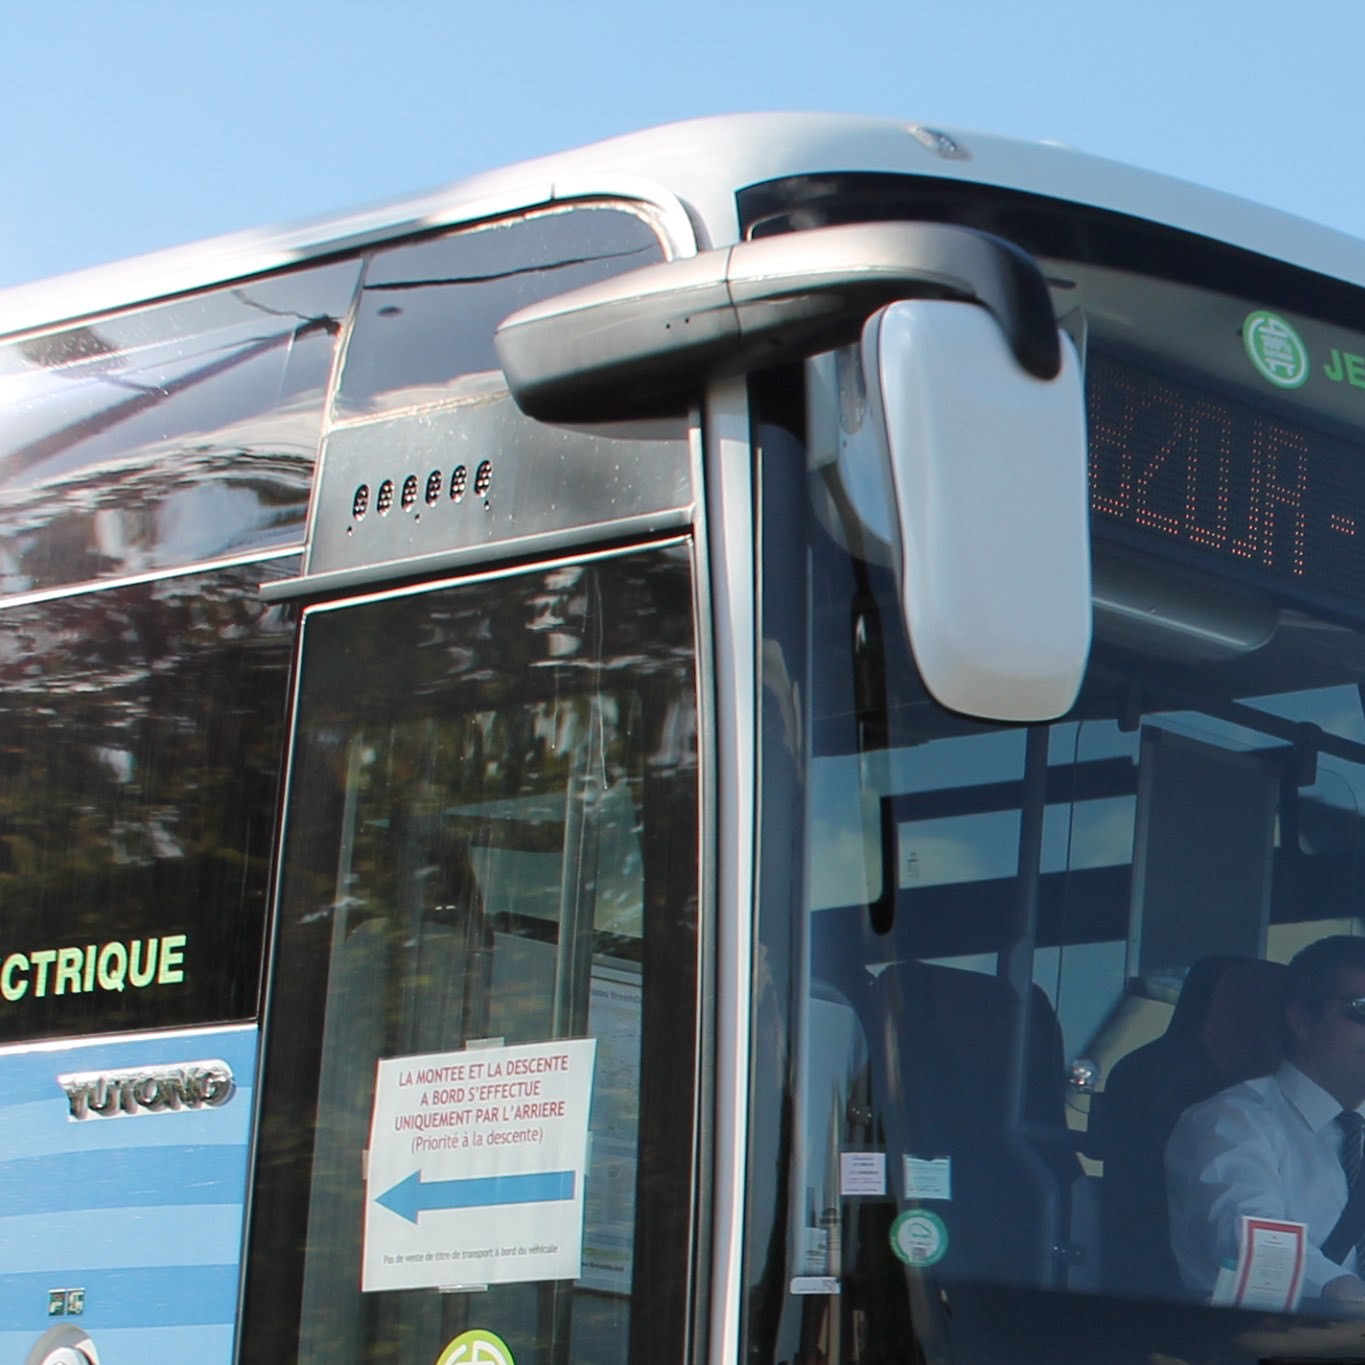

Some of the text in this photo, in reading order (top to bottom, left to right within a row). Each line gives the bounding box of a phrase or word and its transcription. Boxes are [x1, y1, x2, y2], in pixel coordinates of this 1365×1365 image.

[0, 934, 186, 1001] CTRIQUE
[399, 1055, 569, 1086] LA MONTEE ET LA DESCENTE
[57, 1059, 234, 1122] YUTONG
[420, 1081, 541, 1106] A BORD S'EFFECTUE
[394, 1101, 566, 1131] UNIQUEMENT PAR L'ARRIERE
[411, 1126, 543, 1154] (Priorité à la descente)
[396, 1254, 404, 1263] de
[425, 1253, 434, 1262] de
[452, 1251, 460, 1260] de
[462, 1249, 493, 1262] transport
[501, 1247, 516, 1257] bord
[518, 1246, 527, 1256] du
